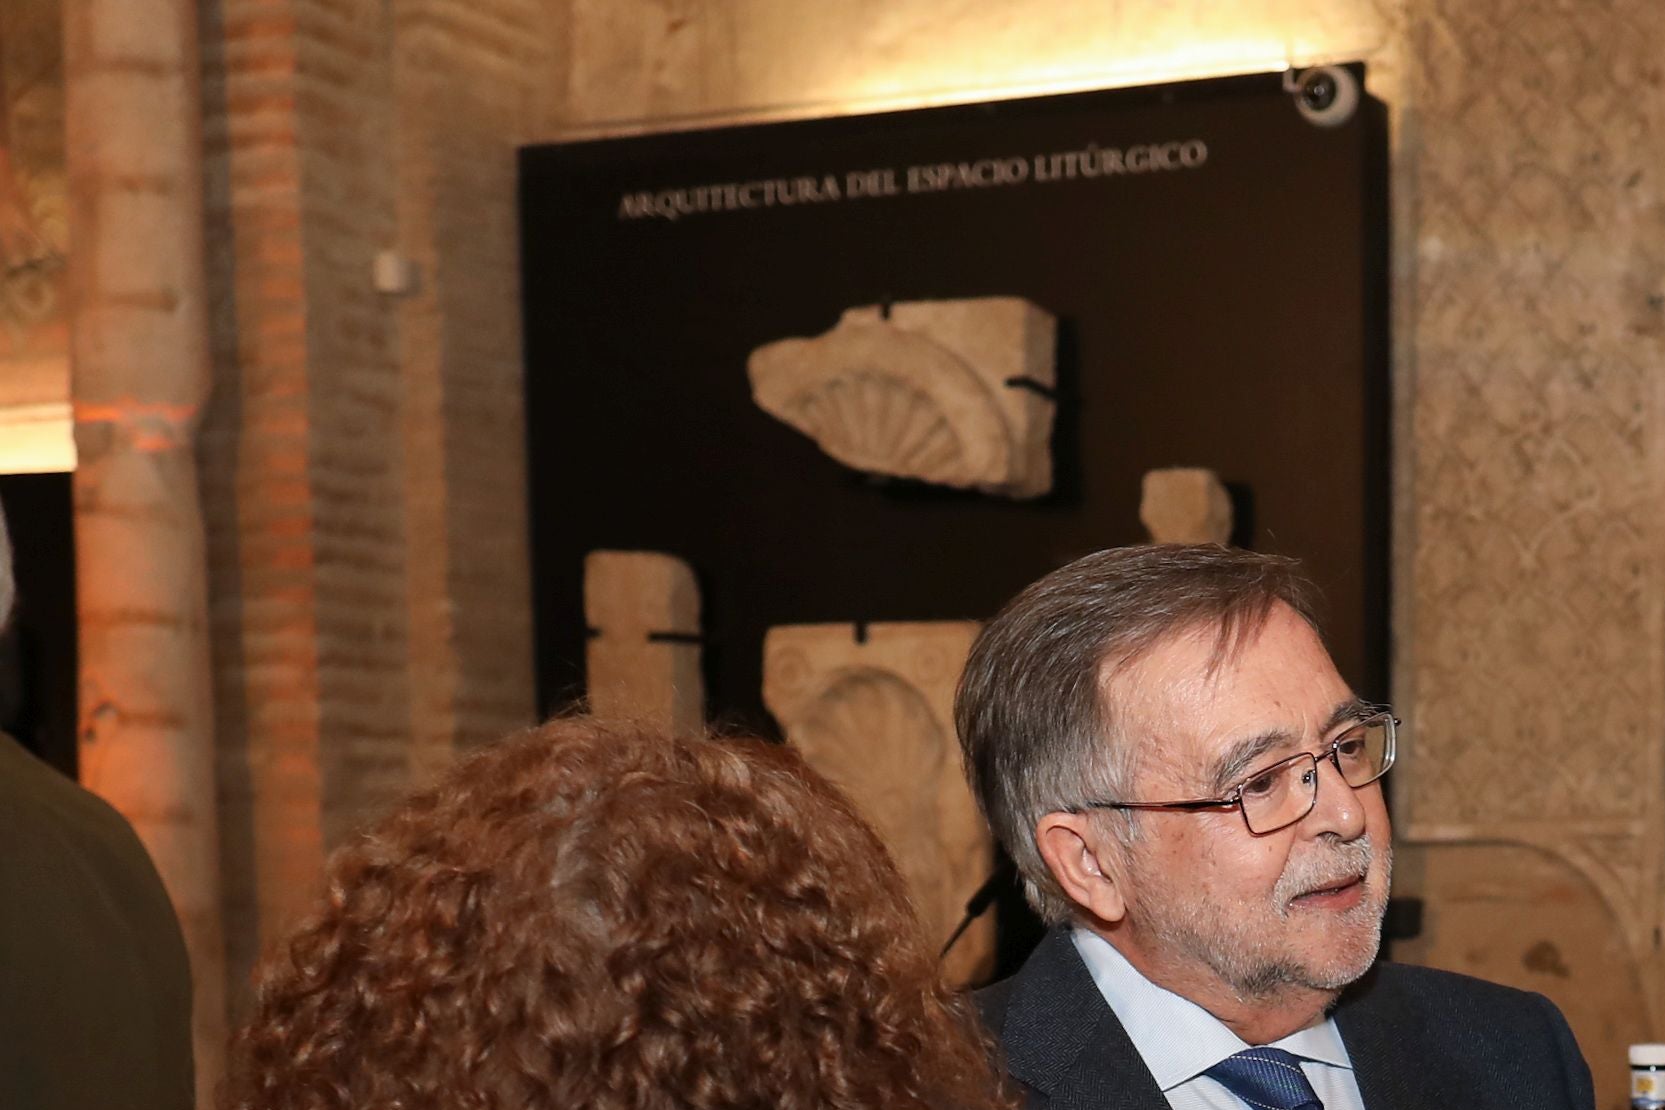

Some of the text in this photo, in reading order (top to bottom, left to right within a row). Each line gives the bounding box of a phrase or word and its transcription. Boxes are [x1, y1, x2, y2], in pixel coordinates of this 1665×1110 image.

[618, 139, 1208, 221] ARQUITECTURA DEL ESPACIO LITÚRGICO
